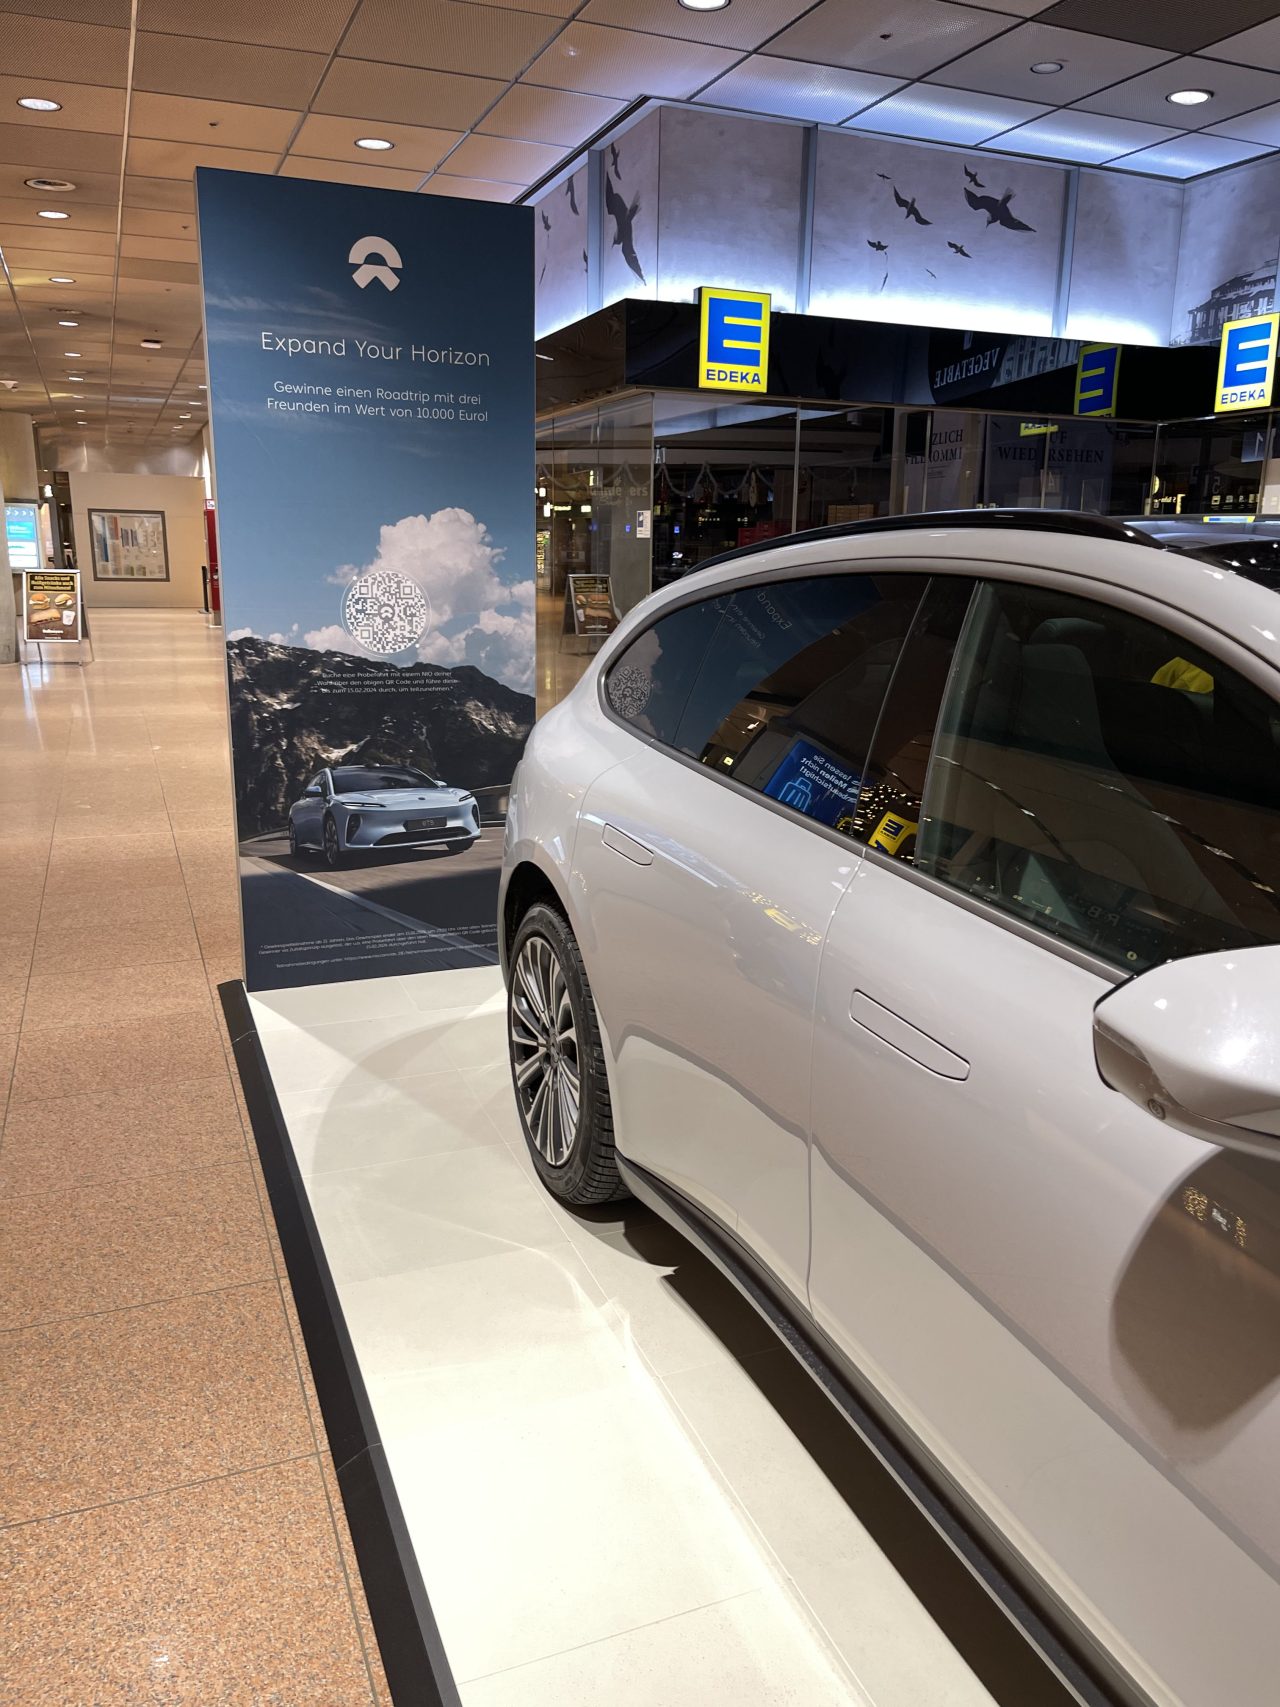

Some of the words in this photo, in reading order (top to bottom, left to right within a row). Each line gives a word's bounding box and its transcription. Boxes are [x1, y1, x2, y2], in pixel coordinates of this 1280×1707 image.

[261, 331, 346, 357] Expand
[354, 340, 403, 361] Your
[411, 344, 491, 366] Horizon
[706, 368, 761, 385] EDEKA
[273, 380, 333, 396] Gewinne
[336, 385, 372, 399] einen
[376, 387, 430, 405] Roadtrip
[434, 392, 455, 404] mit
[458, 392, 482, 406] drei
[1221, 388, 1266, 405] EDEKA
[266, 397, 330, 414] Freunden
[333, 401, 351, 415] im
[354, 403, 386, 417] Wert
[389, 408, 413, 419] von
[416, 406, 455, 421] 10.000
[458, 409, 489, 423] Euro!
[931, 429, 963, 446] ZLICH
[998, 446, 1104, 464] WIEDRSEHEN
